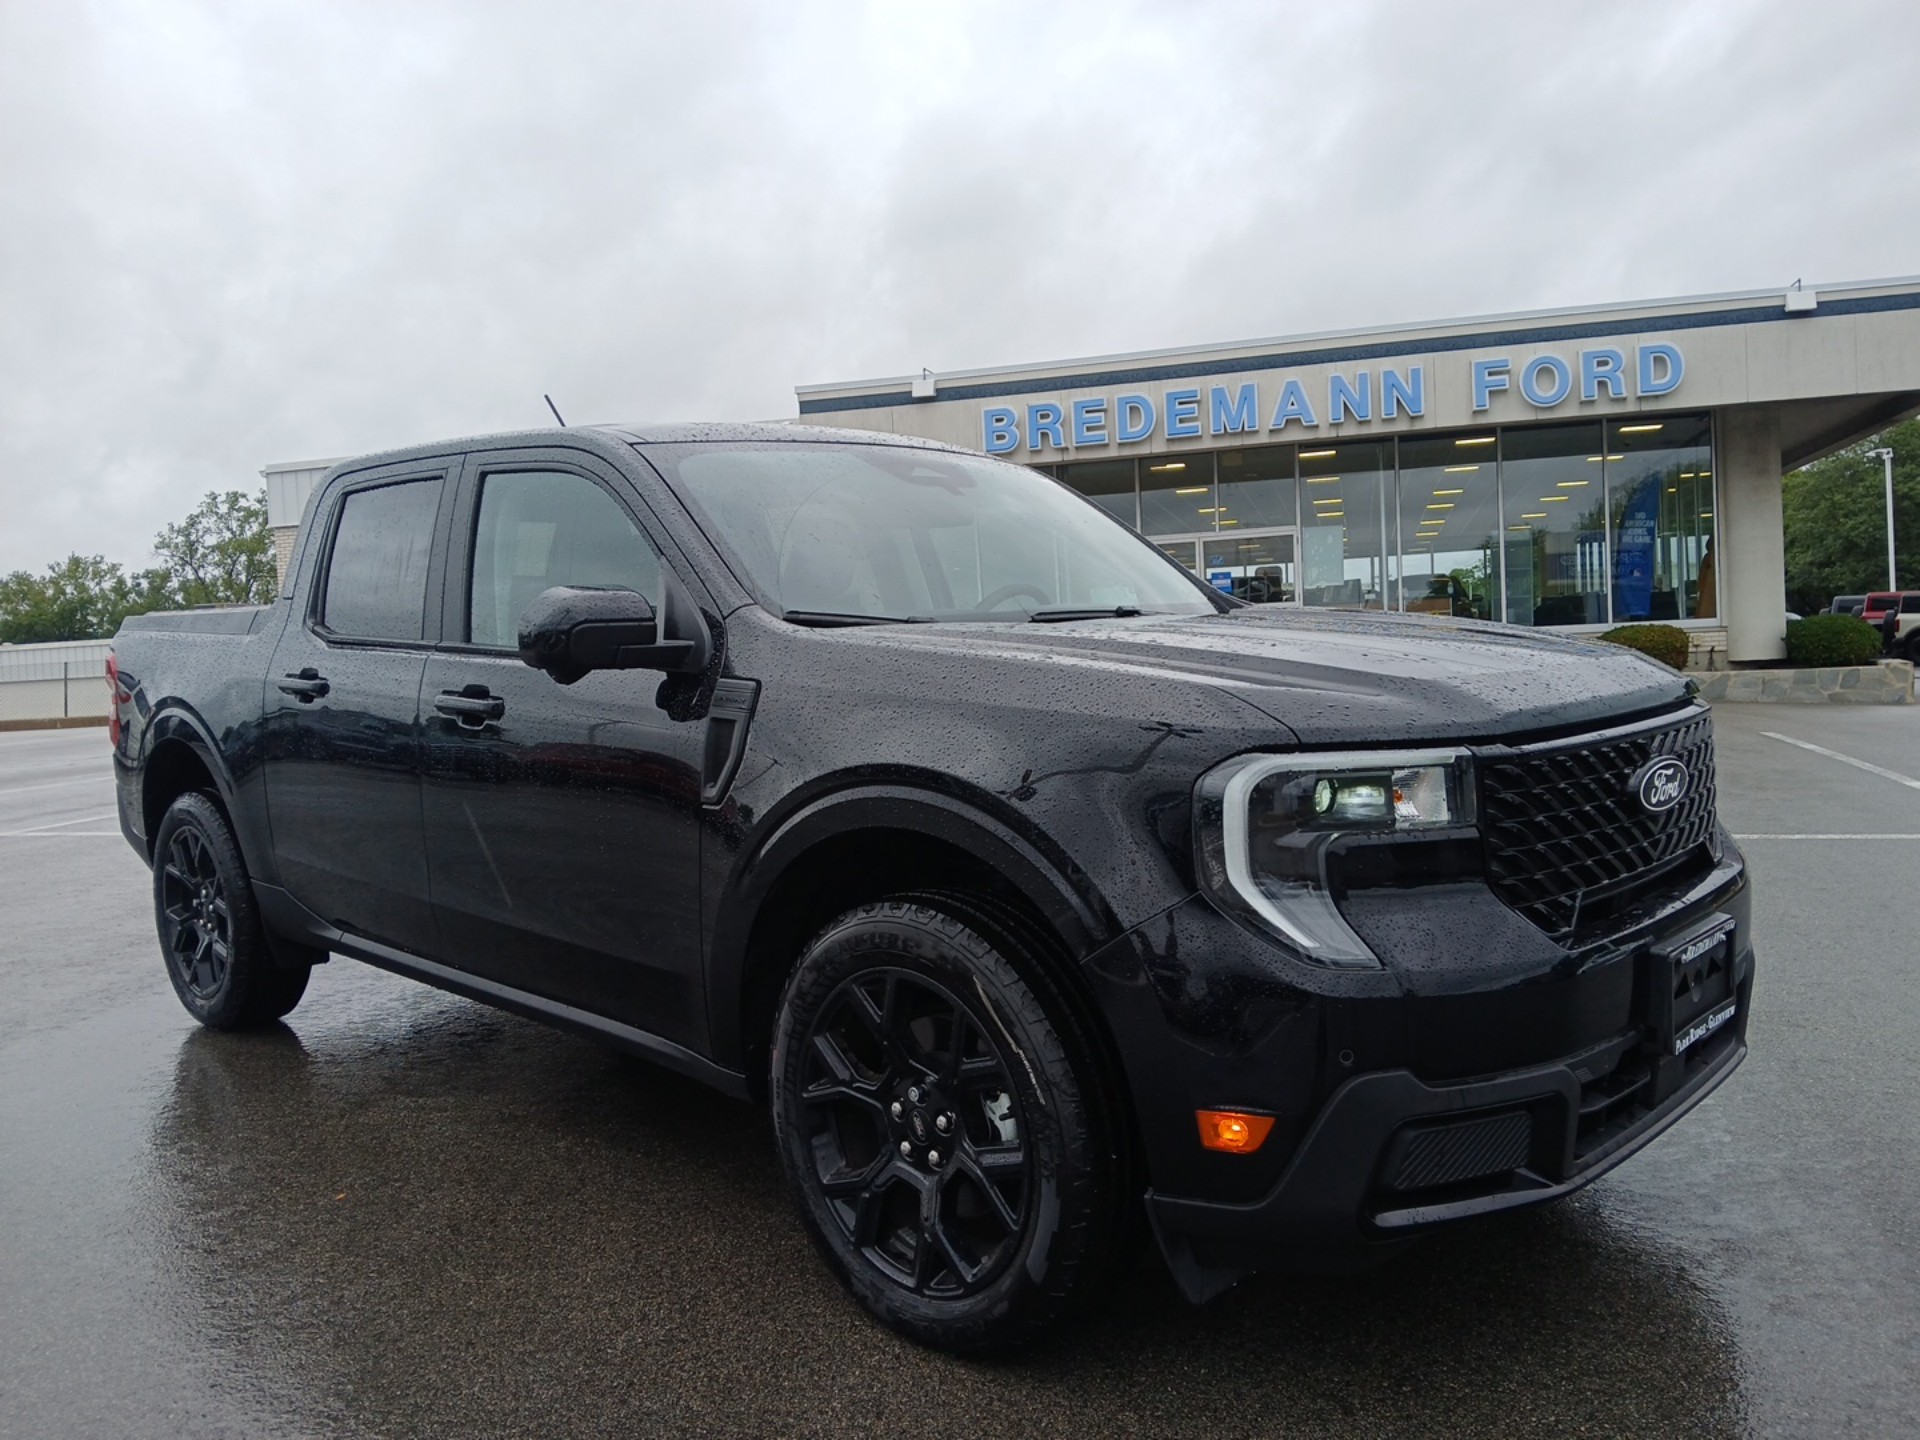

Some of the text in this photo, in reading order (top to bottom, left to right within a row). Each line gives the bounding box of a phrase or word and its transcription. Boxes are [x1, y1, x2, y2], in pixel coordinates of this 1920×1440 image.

[981, 341, 1686, 455] BREDEMANN FORD
[1651, 767, 1681, 805] Ford
